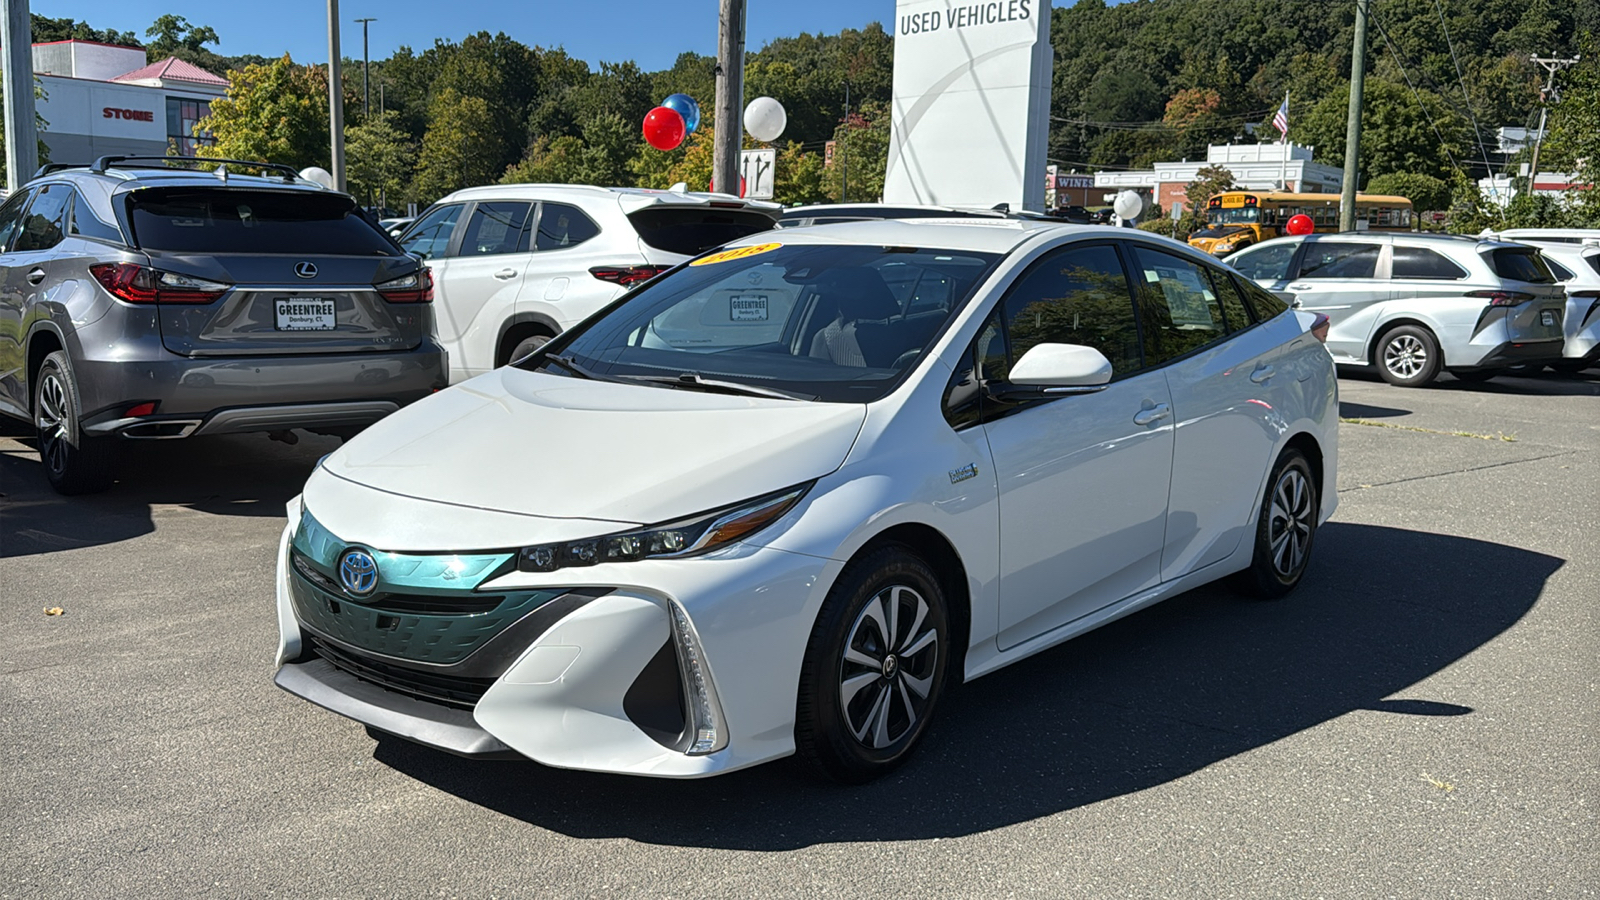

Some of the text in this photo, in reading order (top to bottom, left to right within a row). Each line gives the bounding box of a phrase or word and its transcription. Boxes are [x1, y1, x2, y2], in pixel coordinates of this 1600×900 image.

[901, 0, 1031, 36] USED VEHICLES
[103, 107, 154, 122] STONE
[1058, 177, 1094, 188] WINES
[702, 244, 771, 264] 2018
[279, 304, 333, 316] GREENTREE
[733, 300, 765, 309] GREENTREE
[289, 316, 314, 324] Danbury,
